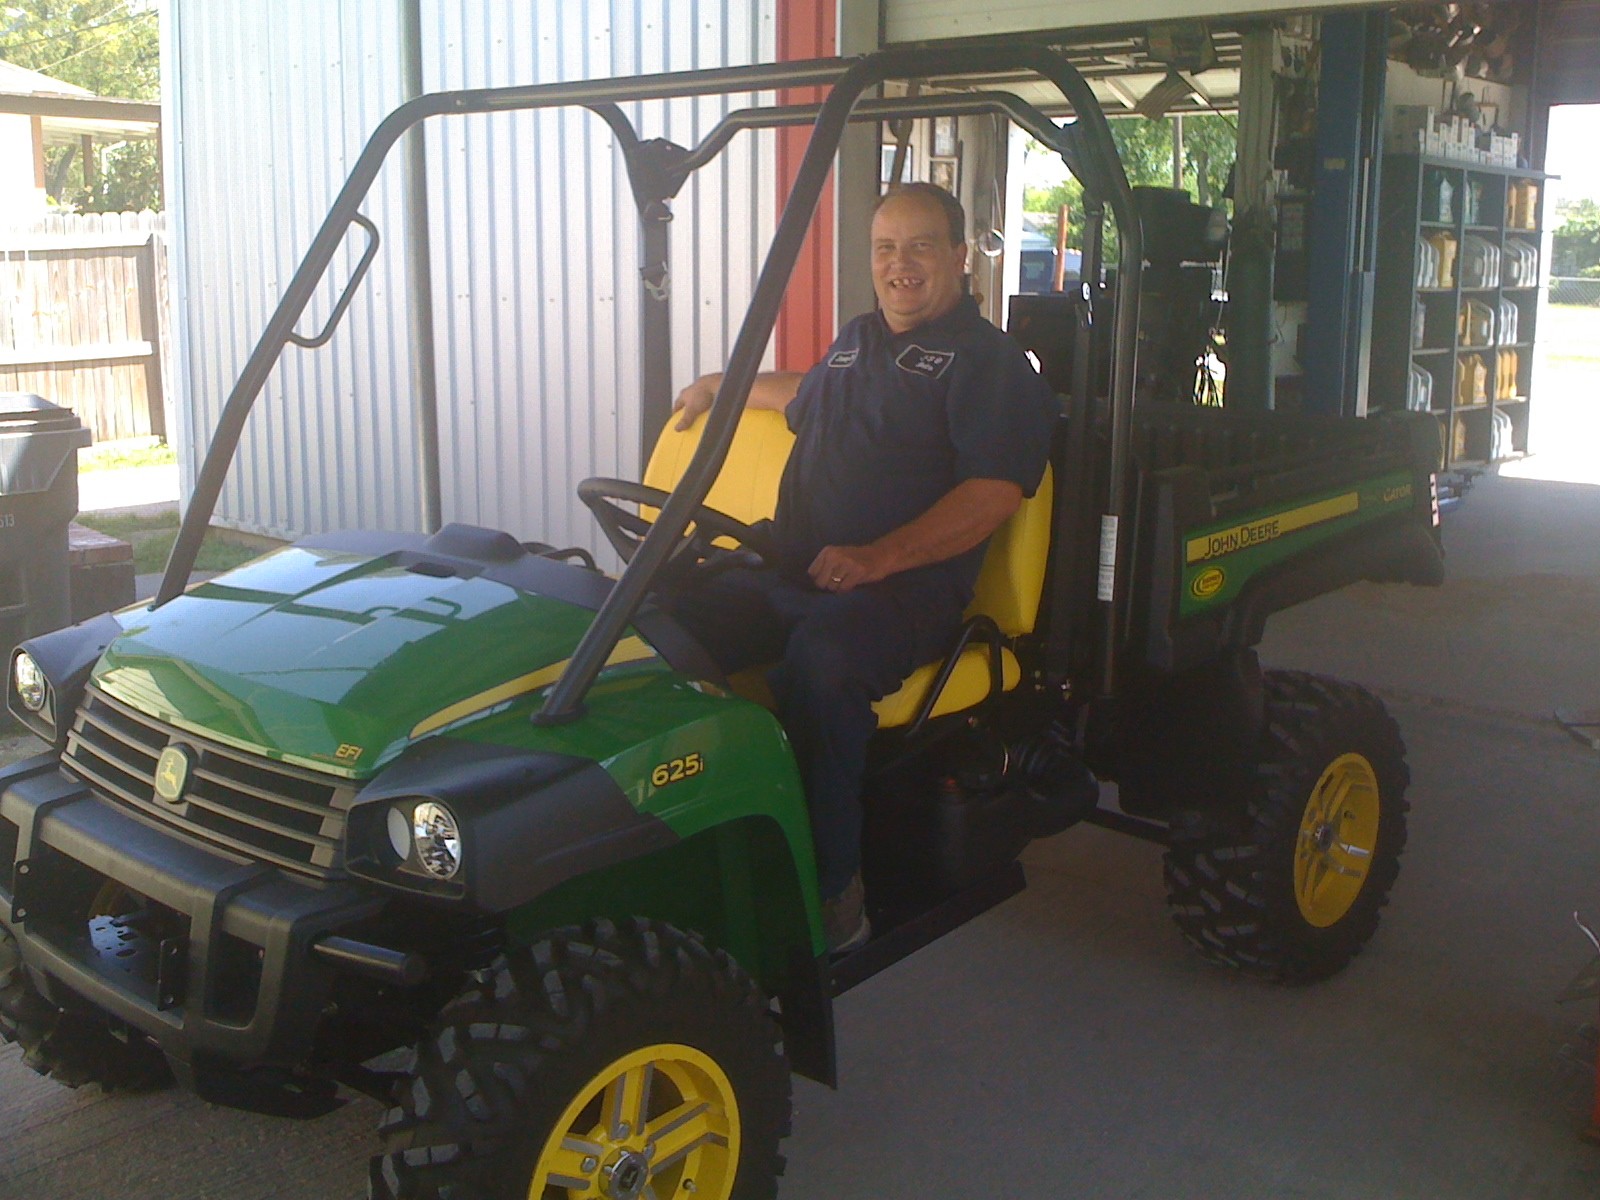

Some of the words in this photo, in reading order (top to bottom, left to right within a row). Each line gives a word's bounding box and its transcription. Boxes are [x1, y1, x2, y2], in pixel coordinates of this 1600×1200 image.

[1204, 532, 1239, 556] JOHN
[1240, 520, 1279, 545] DEERE
[335, 743, 363, 761] EFI
[651, 751, 704, 787] 625i
